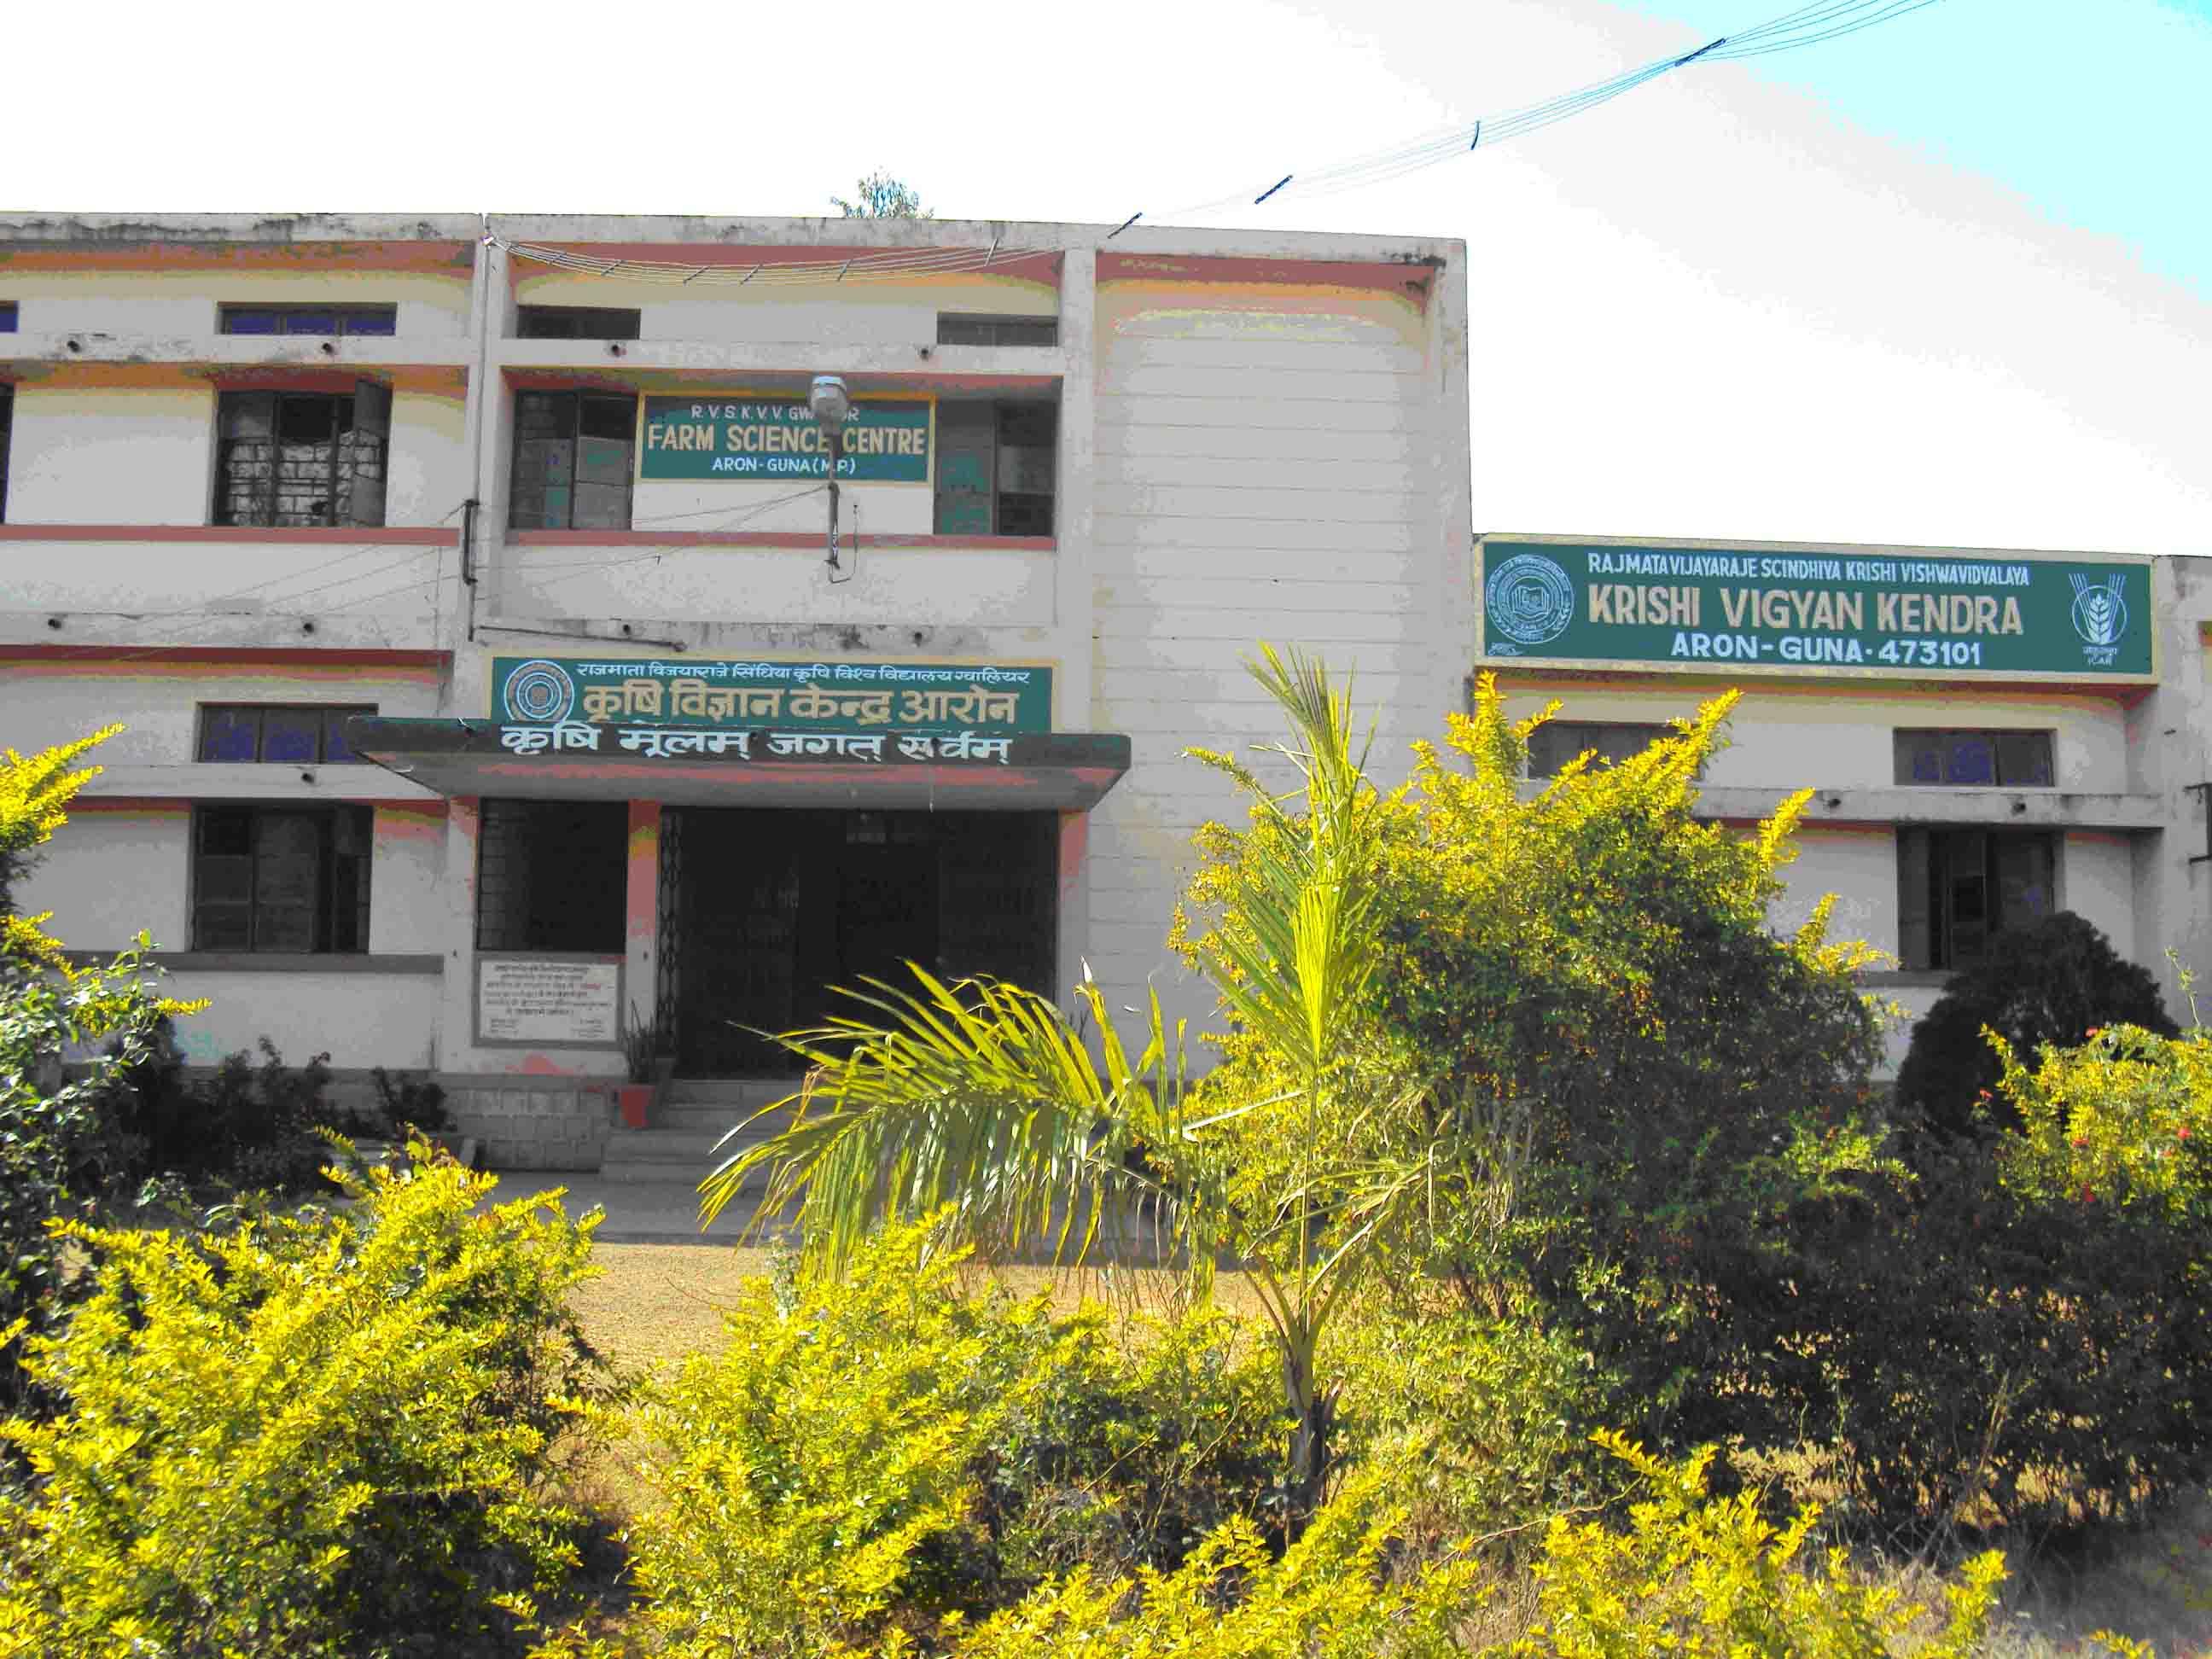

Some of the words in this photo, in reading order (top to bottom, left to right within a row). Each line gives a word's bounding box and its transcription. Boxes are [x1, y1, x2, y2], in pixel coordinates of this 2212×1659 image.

[647, 424, 714, 451] FARM
[726, 425, 830, 453] SCIENCE
[842, 428, 926, 455] CENTRE
[1588, 552, 1668, 574] RAJMATA
[1669, 555, 1758, 578] VIJAYARAJE
[1761, 557, 1841, 581] SCINDHIYA
[1846, 561, 1896, 583] KRISHI
[1901, 562, 2030, 586] VISHWAVIDYALAYA
[1588, 584, 1701, 627] KRISHI
[1720, 587, 1864, 631] VIGYAN
[1877, 592, 2024, 635] KENDRA
[577, 663, 645, 677] राजमाता
[648, 661, 728, 678] विजयाराजे
[731, 662, 792, 679] सिंधिया
[794, 663, 830, 684] कृषि
[954, 667, 1031, 684] ग्वालियर
[583, 679, 664, 723] कृषि
[668, 679, 785, 723] विज्ञान
[789, 683, 894, 725] केन्द्र
[899, 684, 1020, 724] आरोन
[501, 721, 602, 755] कृषि
